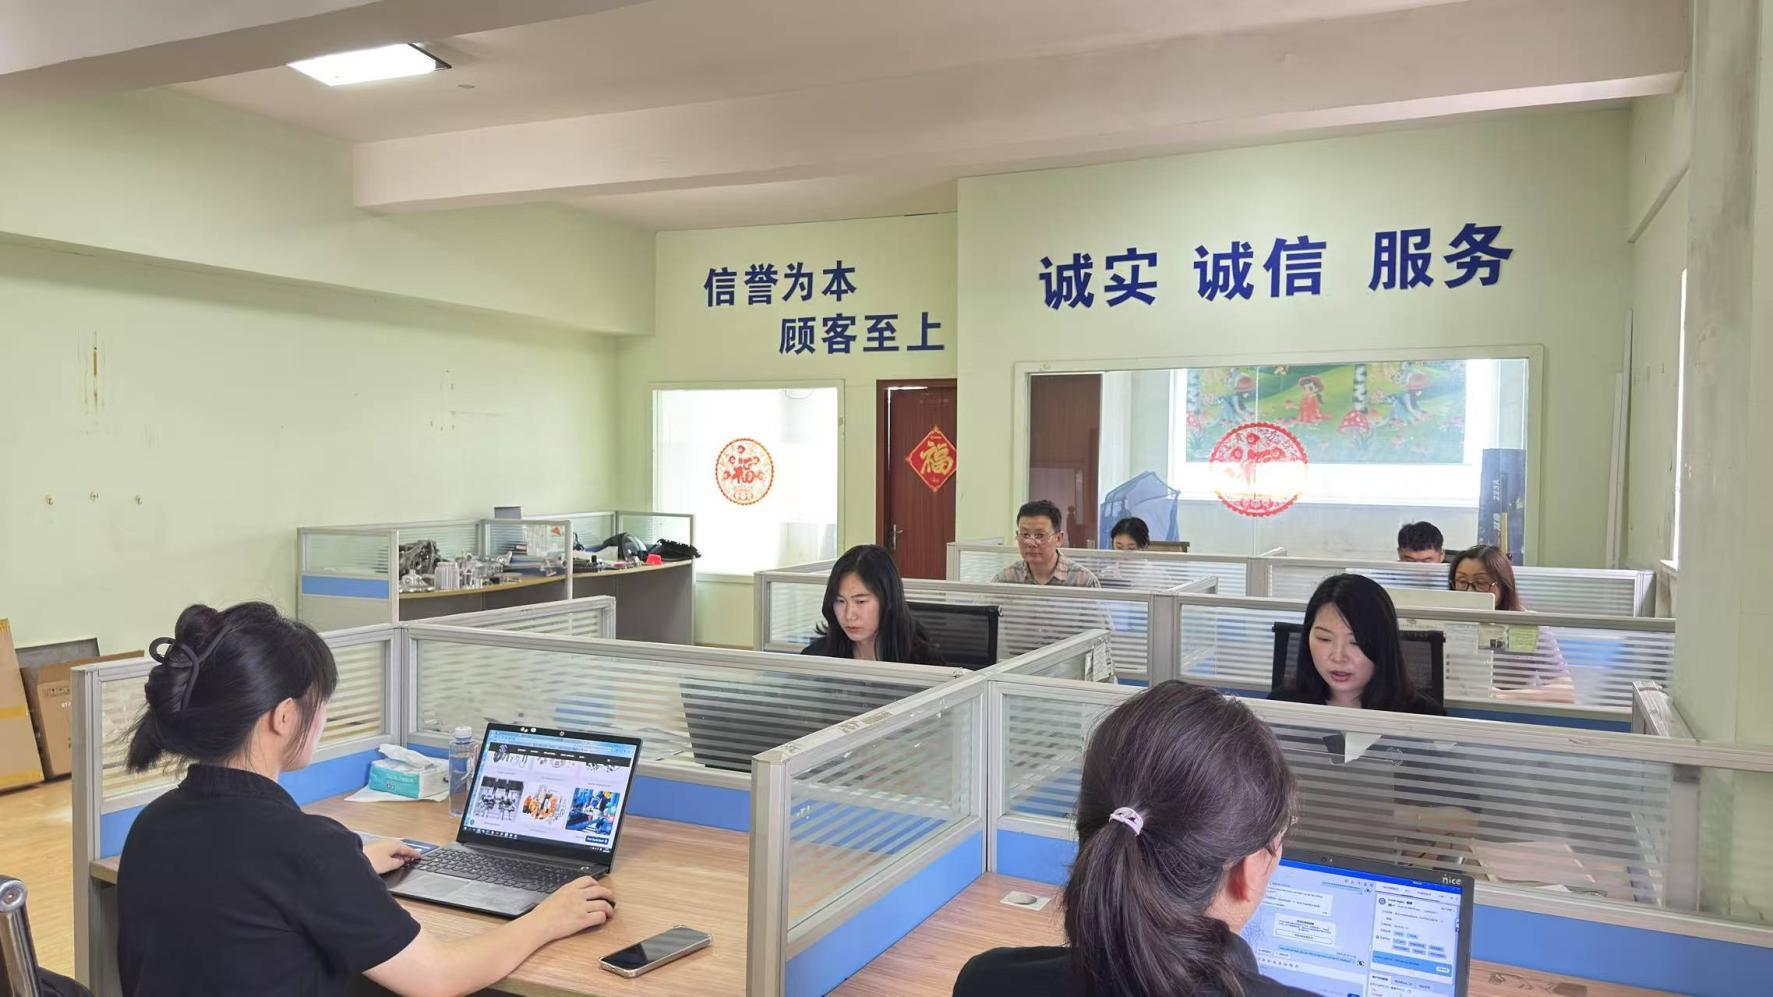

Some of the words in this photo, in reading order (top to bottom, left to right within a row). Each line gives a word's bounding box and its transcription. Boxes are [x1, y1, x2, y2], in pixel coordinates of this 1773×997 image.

[704, 260, 857, 307] 信誉为本
[1039, 248, 1159, 310] 诚实
[1193, 235, 1327, 301] 诚信
[1368, 223, 1514, 291] 服务
[779, 312, 945, 355] 顾客至上
[920, 440, 954, 476] 福
